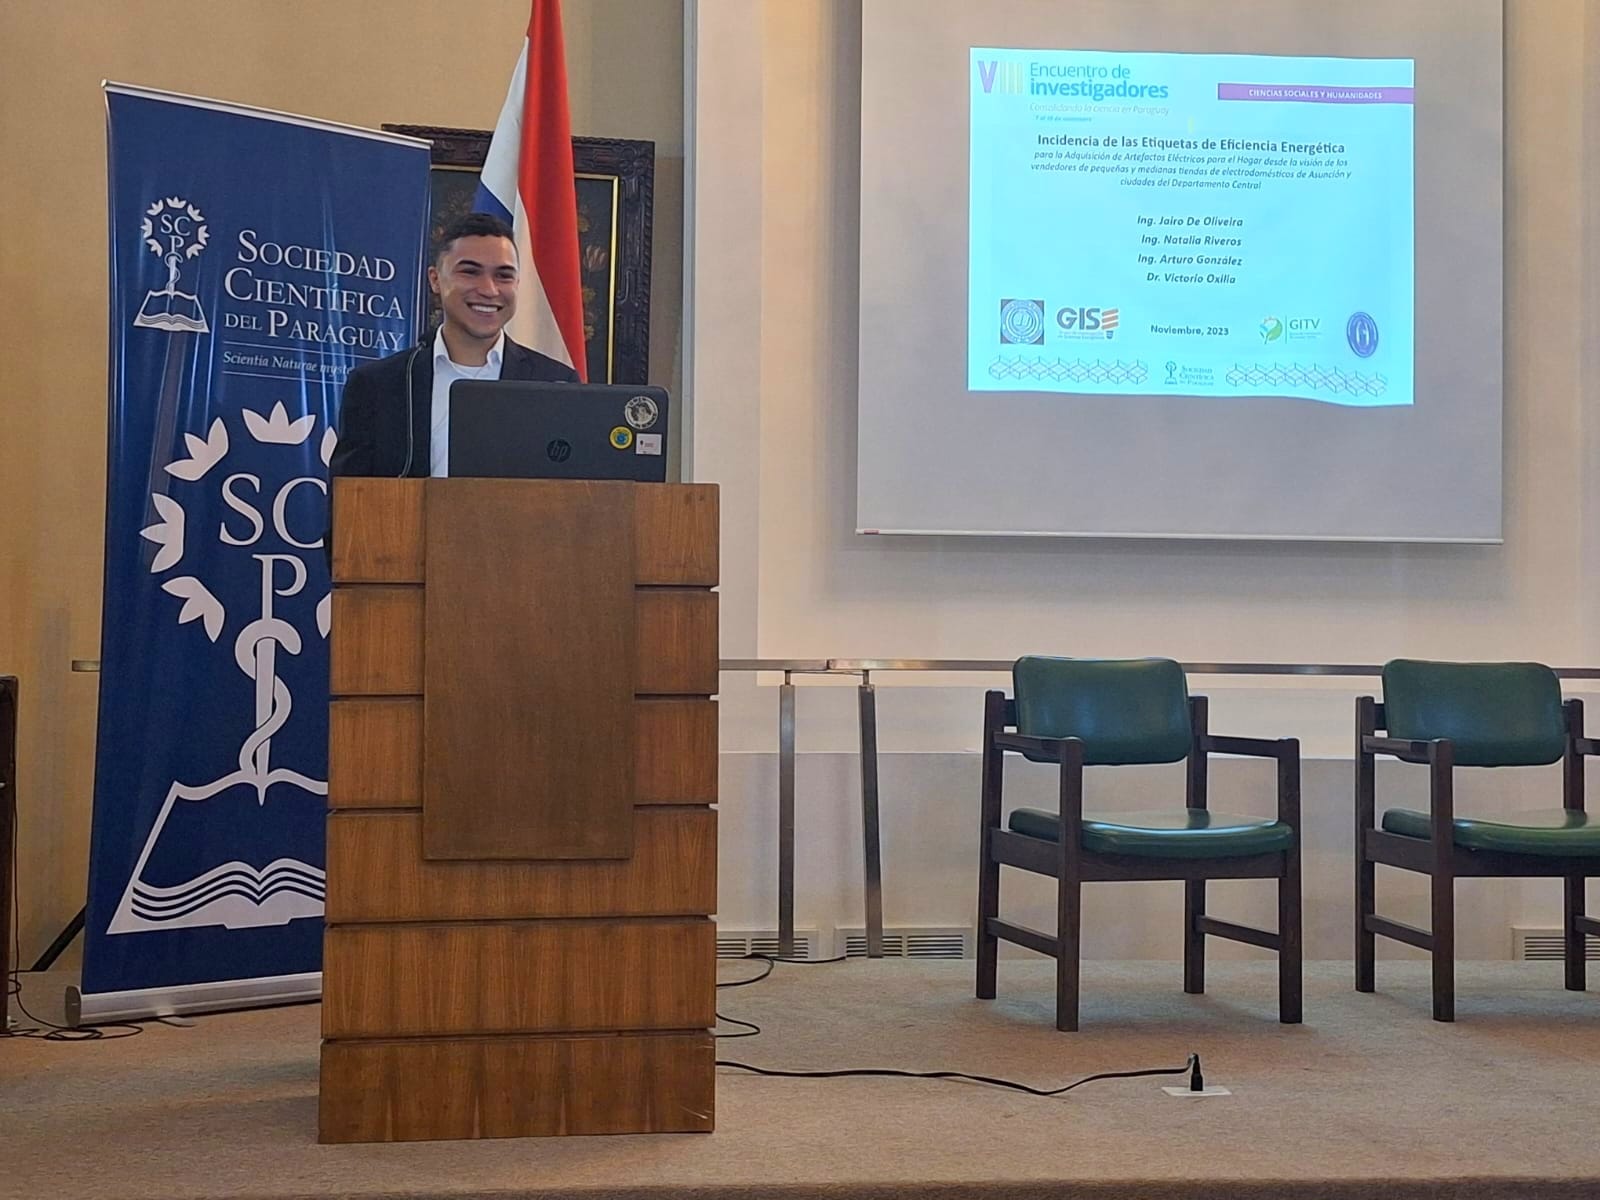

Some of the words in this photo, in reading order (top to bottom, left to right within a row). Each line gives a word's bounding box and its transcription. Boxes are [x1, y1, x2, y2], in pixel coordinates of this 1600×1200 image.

[1030, 62, 1107, 78] Encuentro
[1111, 64, 1131, 79] de
[1030, 78, 1169, 101] investigadores
[1249, 89, 1282, 97] CIENCIAS
[1284, 90, 1318, 98] SOCIALES
[1320, 90, 1326, 98] Y
[1327, 91, 1382, 99] HUMANIDADES
[1133, 105, 1169, 116] Paraguay
[1037, 134, 1099, 147] Incidencia
[1103, 136, 1118, 148] de
[1122, 136, 1138, 148] las
[1142, 137, 1198, 150] Etiquetas
[1202, 138, 1217, 150] de
[1221, 139, 1278, 152] Eficiencia
[1281, 141, 1345, 156] Energética
[1034, 152, 1054, 161] para
[1055, 151, 1063, 160] la
[1064, 151, 1110, 162] Adquisición
[1112, 152, 1122, 161] de
[1124, 153, 1166, 163] Artefactos
[1168, 153, 1205, 164] Eléctricos
[1206, 156, 1226, 165] para
[1228, 156, 1236, 164] el
[1237, 156, 1263, 166] Hogar
[1264, 157, 1288, 166] desde
[1289, 158, 1298, 166] la
[1300, 158, 1323, 167] visión
[1325, 158, 1335, 167] de
[1336, 158, 1348, 167] los
[1031, 163, 1077, 172] vendedores
[1079, 163, 1089, 172] de
[1090, 165, 1129, 174] pequeñas
[1130, 167, 1136, 175] y
[1138, 165, 1176, 175] medianas
[1179, 167, 1208, 176] tiendas
[1210, 168, 1220, 176] de
[1222, 168, 1295, 178] electrodomésticos
[1296, 169, 1307, 178] de
[1308, 169, 1345, 179] Asunción
[1346, 171, 1352, 180] y
[1120, 178, 1155, 187] ciudades
[1157, 178, 1170, 187] del
[1172, 179, 1230, 189] Departamento
[1232, 180, 1262, 190] Central
[1137, 215, 1157, 227] Ing.
[1159, 216, 1184, 227] Jairo
[1186, 216, 1200, 226] De
[1204, 216, 1244, 227] Oliveira
[1141, 234, 1161, 246] Ing.
[1164, 235, 1202, 246] Natalia
[1204, 236, 1242, 247] Riveros
[237, 229, 396, 282] SOCIEDAD
[1137, 254, 1157, 266] Ing.
[1160, 254, 1194, 265] Arturo
[1196, 255, 1243, 266] González
[1146, 272, 1161, 282] Dr.
[1164, 273, 1204, 283] Victorio
[1206, 274, 1236, 284] Oxilia
[224, 267, 406, 321] CIENTÍFICA
[224, 313, 263, 332] DEL
[267, 309, 405, 352] PARAGUAY
[1150, 325, 1204, 336] Noviembre,
[1206, 326, 1230, 336] 2023
[1289, 318, 1321, 330] GITV
[223, 351, 269, 367] Scientia
[271, 355, 318, 372] Naturae
